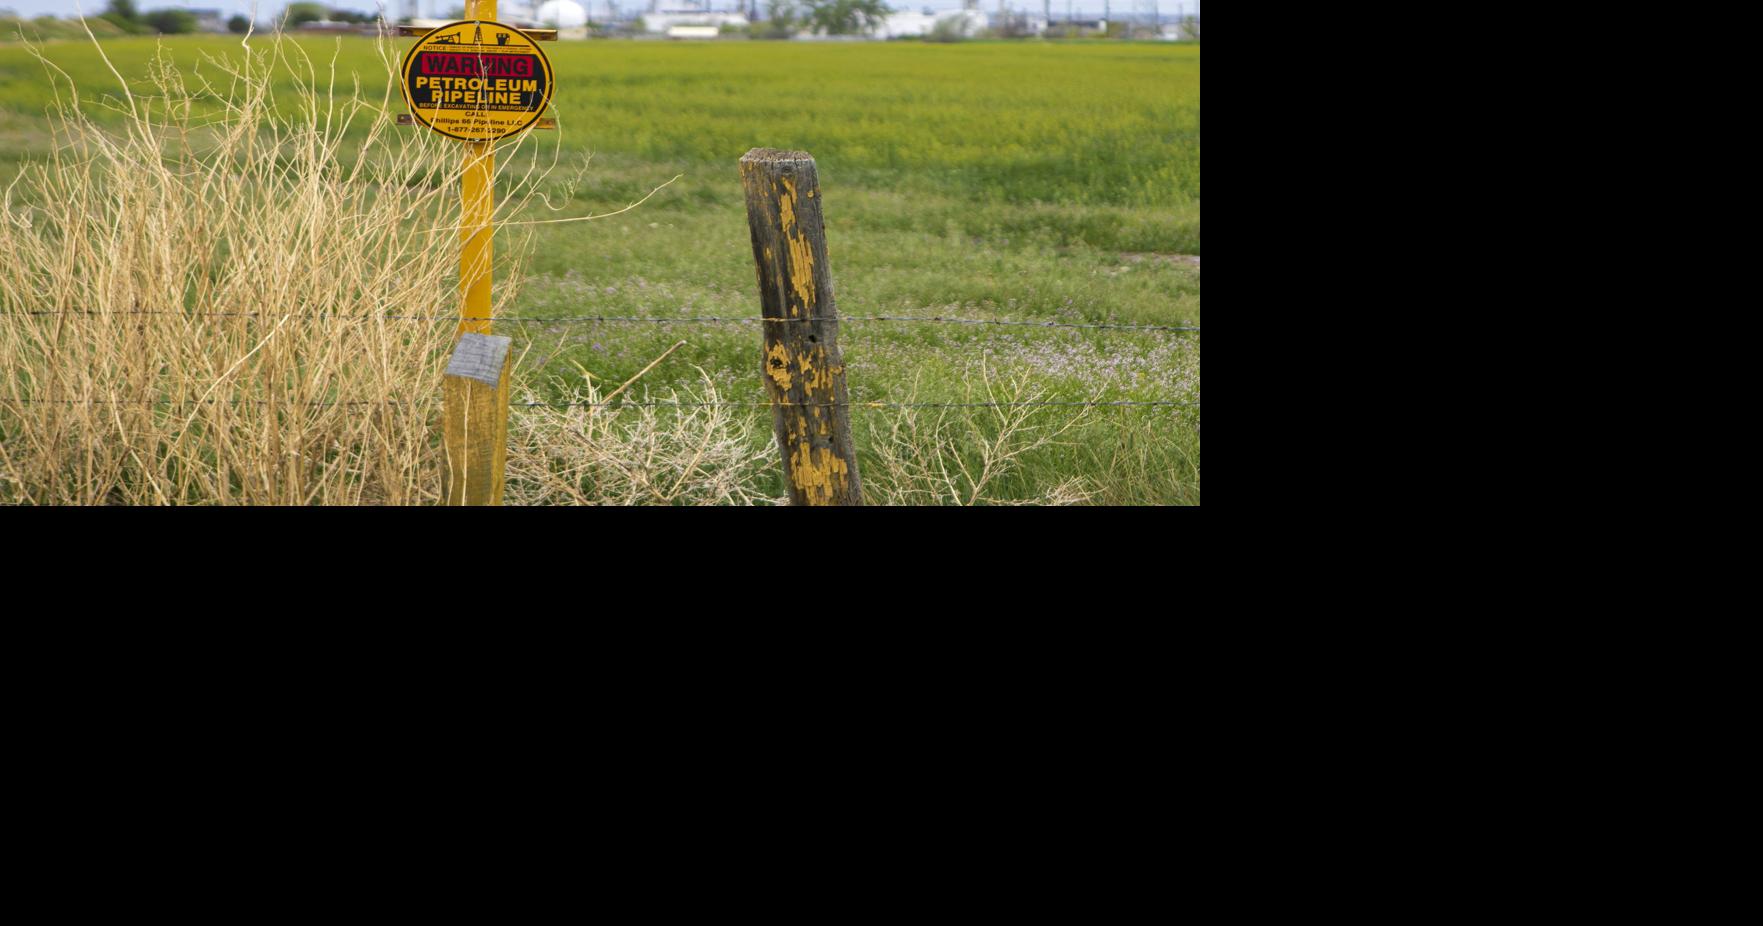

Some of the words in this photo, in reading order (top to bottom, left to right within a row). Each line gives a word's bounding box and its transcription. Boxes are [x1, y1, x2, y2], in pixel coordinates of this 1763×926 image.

[427, 56, 528, 75] WARNING
[416, 77, 537, 92] PETROLEUM
[431, 90, 521, 105] PIPELINE
